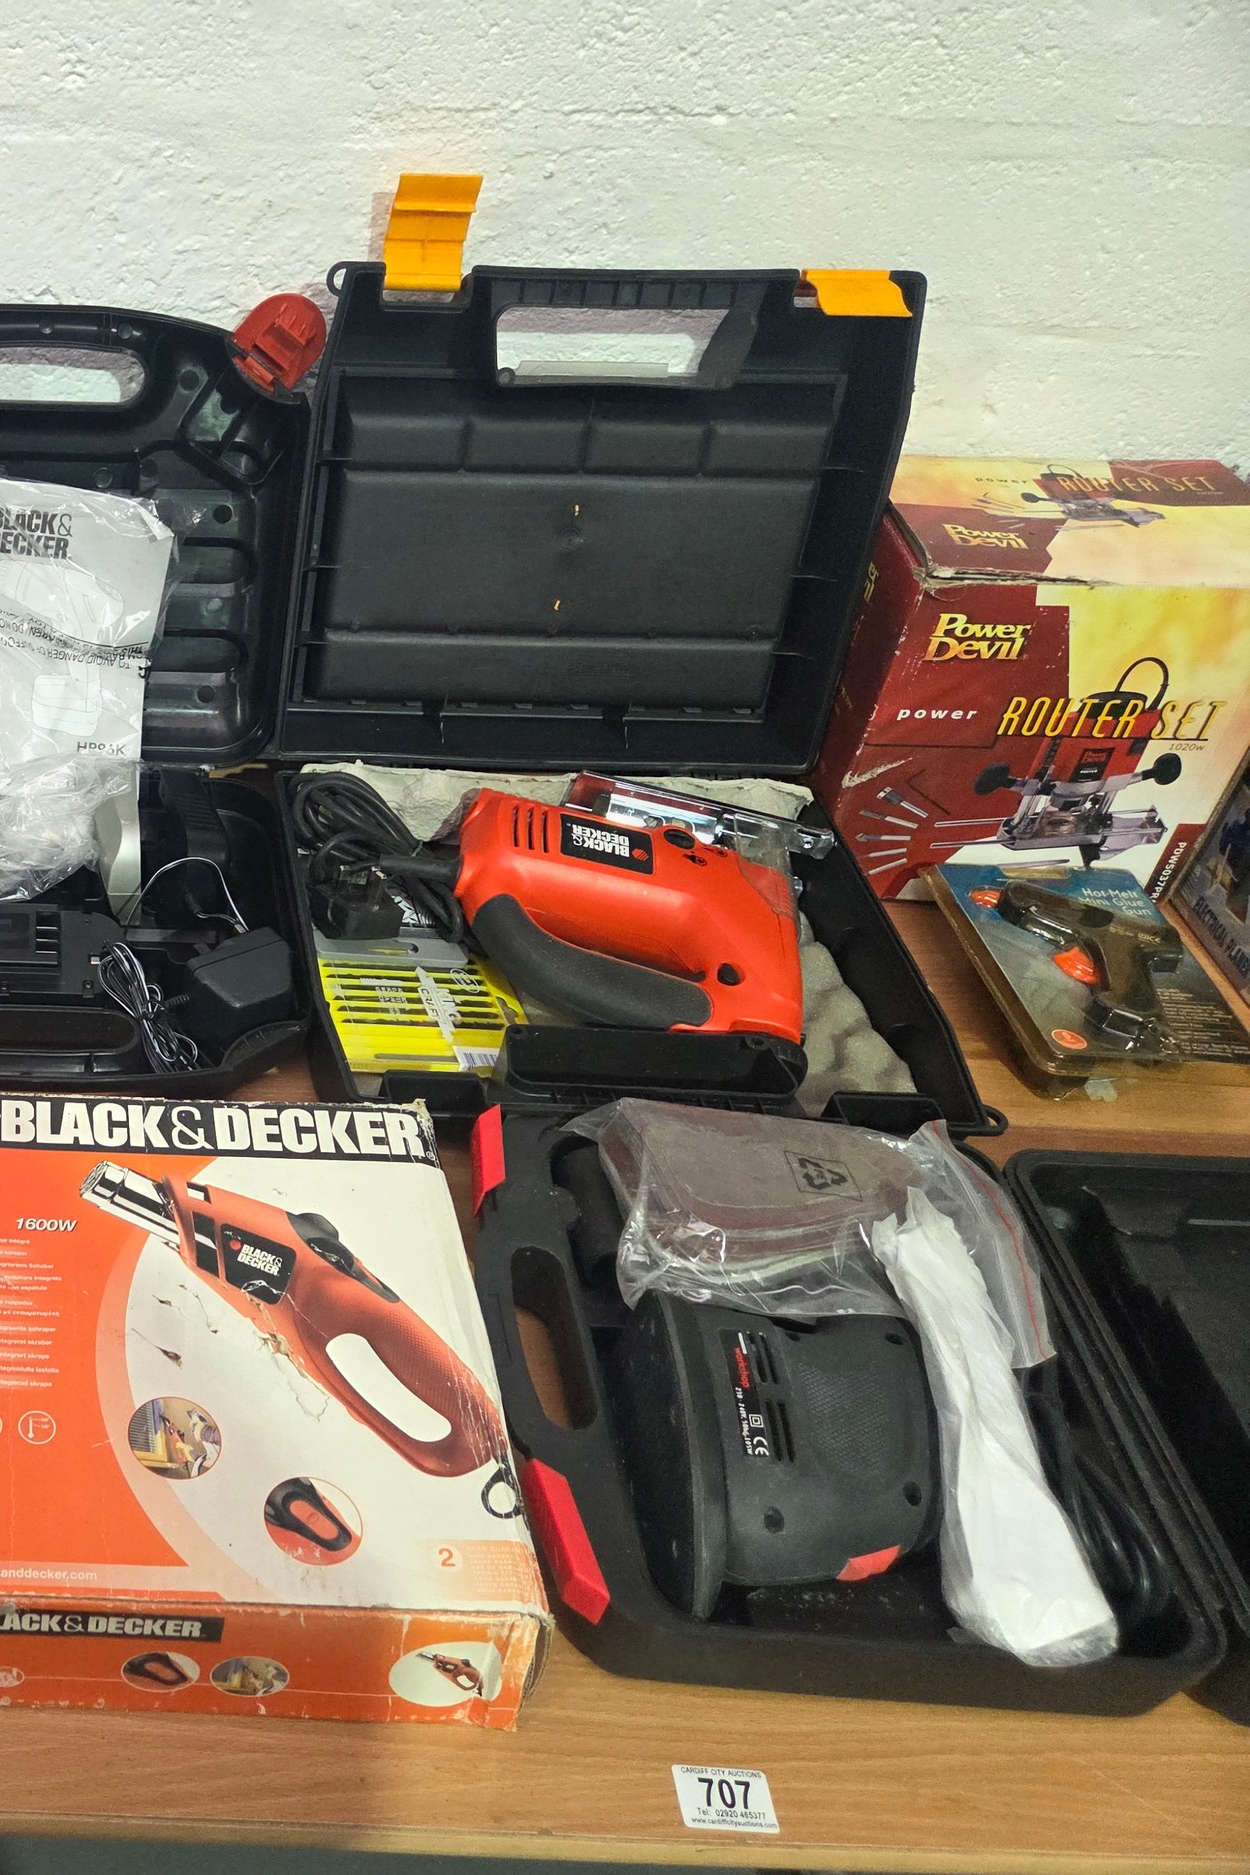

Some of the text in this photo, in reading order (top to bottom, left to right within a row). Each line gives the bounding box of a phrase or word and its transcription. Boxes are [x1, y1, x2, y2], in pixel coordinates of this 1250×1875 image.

[1056, 476, 1157, 492] ROUTER
[1165, 476, 1216, 492] SET
[942, 523, 1020, 539] Power
[952, 534, 1029, 549] Devil
[932, 612, 1032, 638] Power
[923, 636, 1025, 661] Devil
[896, 696, 1229, 741] power ROUTER SET
[572, 824, 629, 846] DECKER
[1112, 898, 1146, 908] Glue
[1122, 906, 1152, 916] Gun
[15, 1217, 78, 1233] 1600W
[237, 1253, 280, 1276] DECKER
[734, 1346, 750, 1389] workshop
[438, 1547, 456, 1568] 2
[680, 1766, 762, 1779] CARDIFF CITY AUCTIONS
[697, 1777, 751, 1810] 707
[696, 1807, 712, 1816] Tel:
[715, 1809, 739, 1818] 02920
